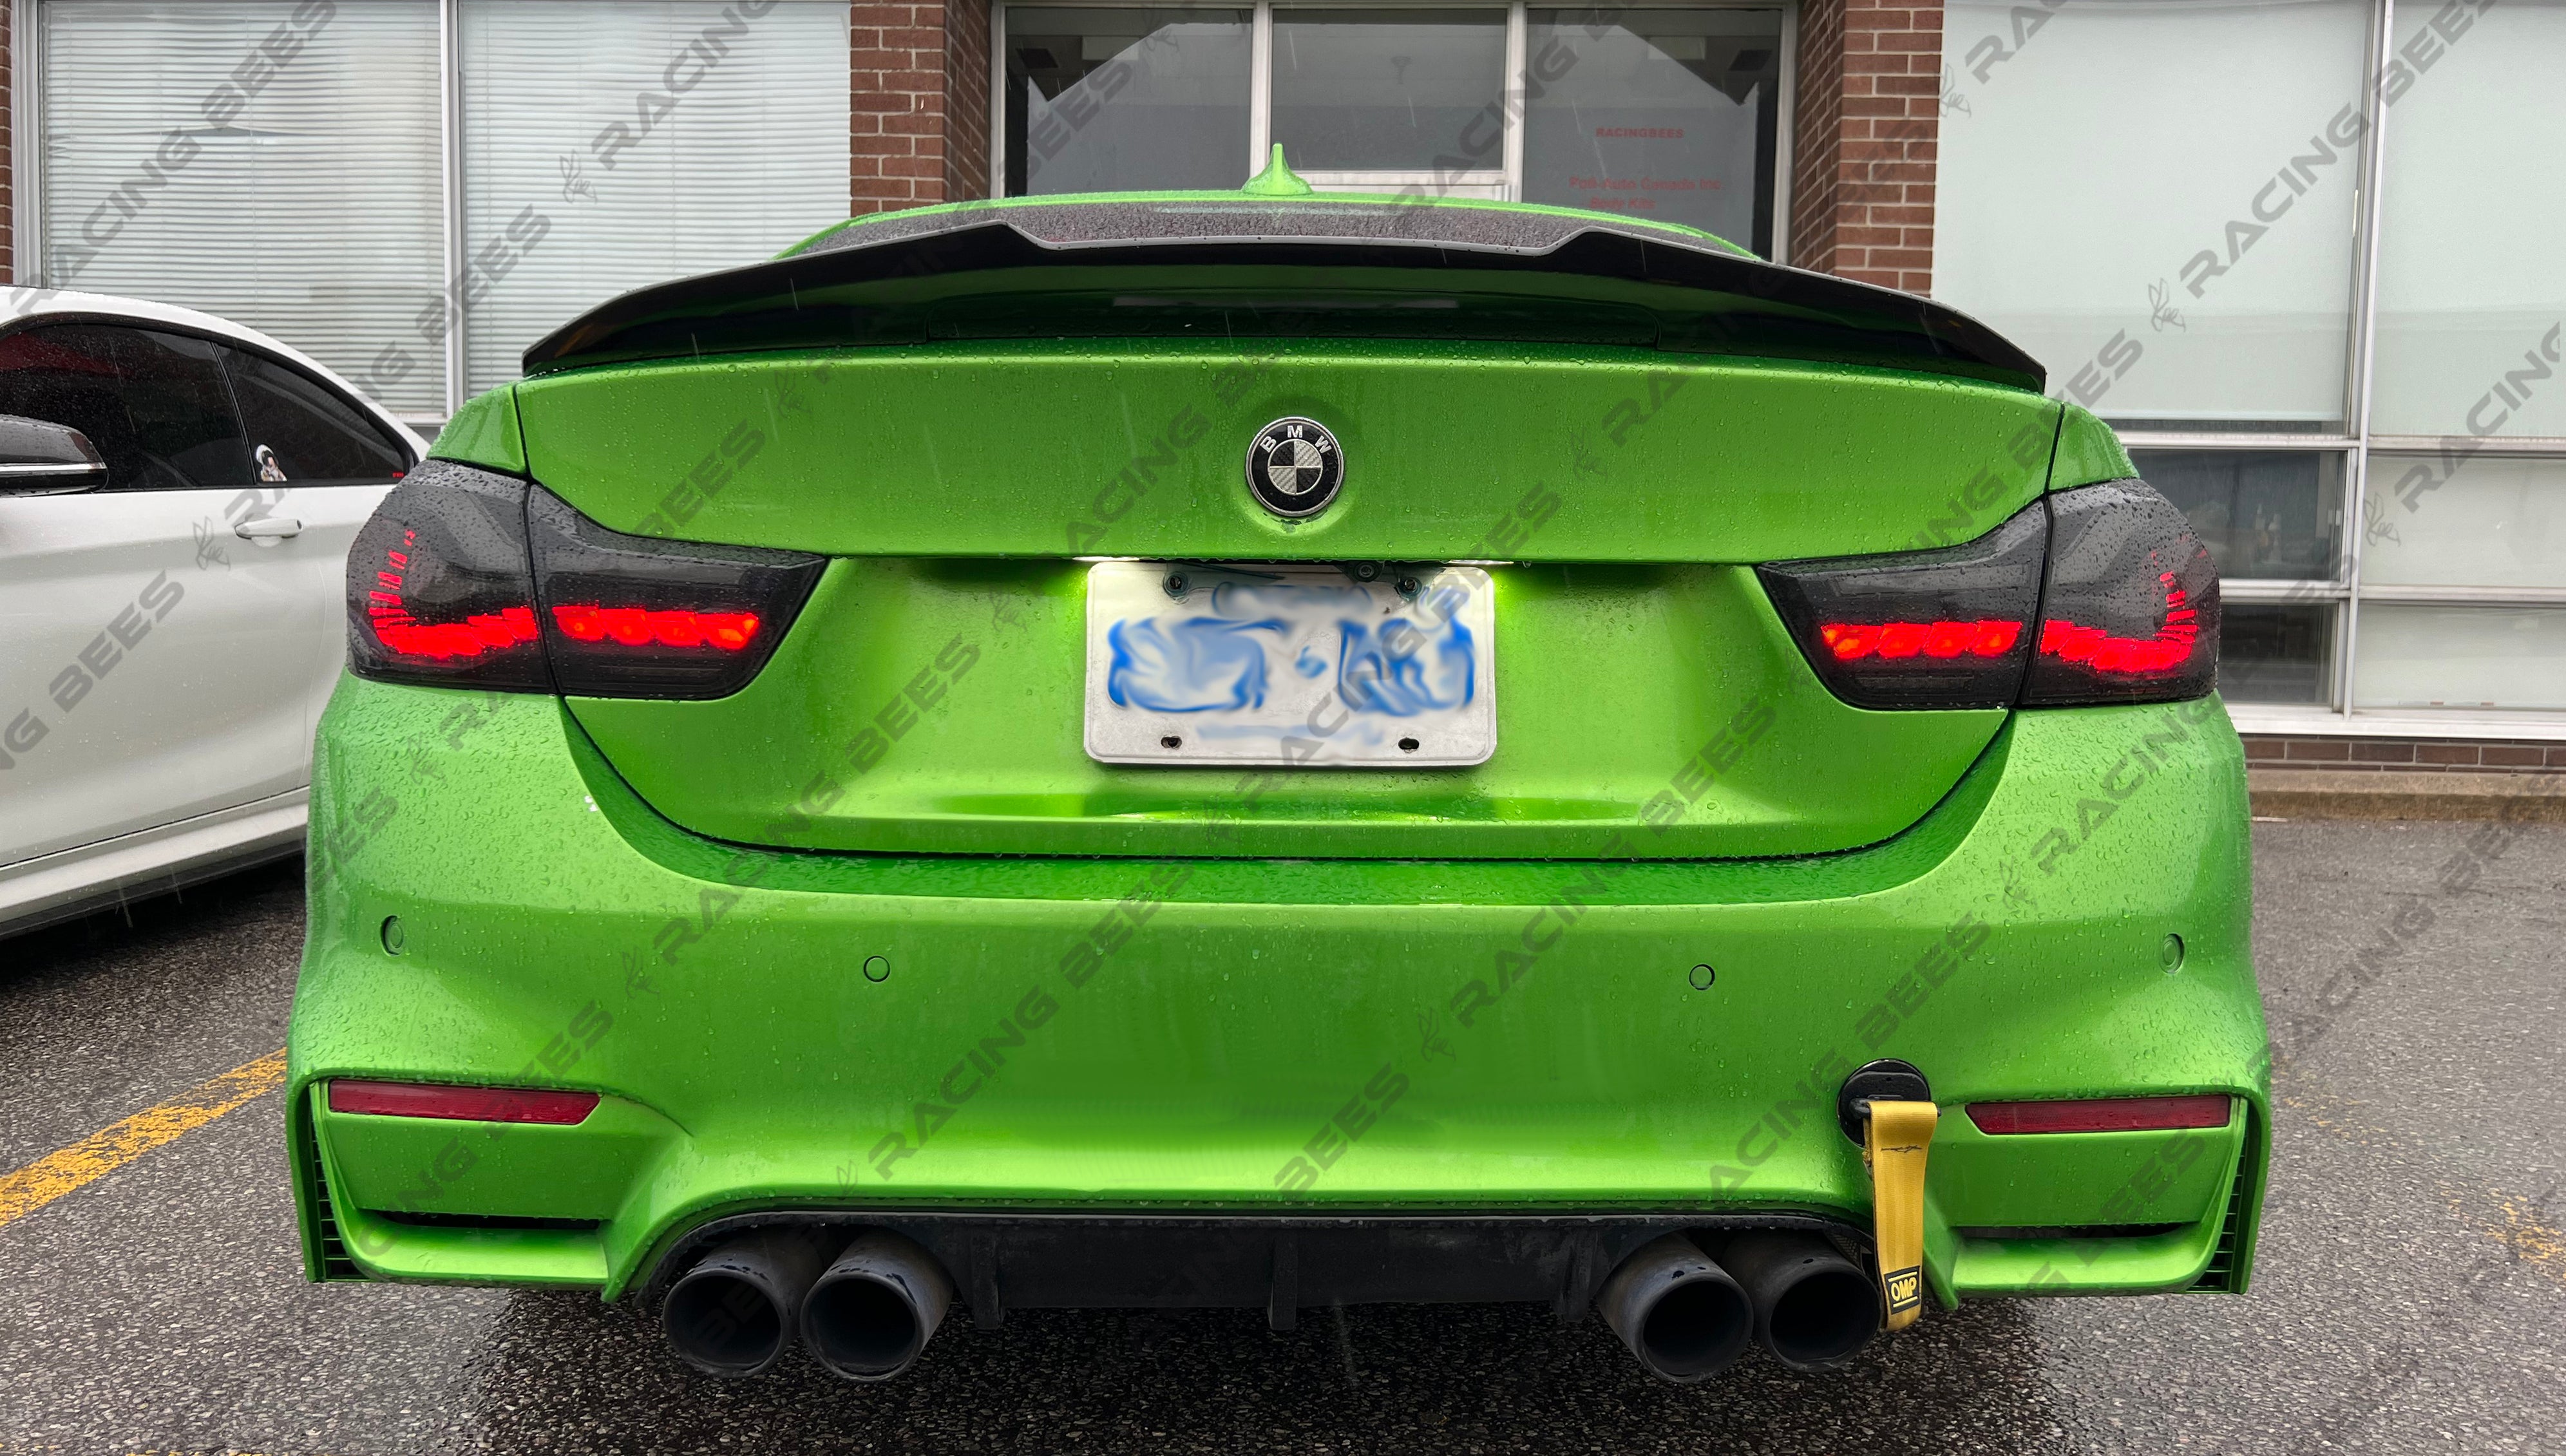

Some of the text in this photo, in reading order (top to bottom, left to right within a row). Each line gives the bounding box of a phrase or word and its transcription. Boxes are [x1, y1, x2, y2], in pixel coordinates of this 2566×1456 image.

[1595, 128, 1684, 138] RACINGBEES
[1260, 425, 1331, 453] BMW
[1891, 1277, 1917, 1301] OMP
